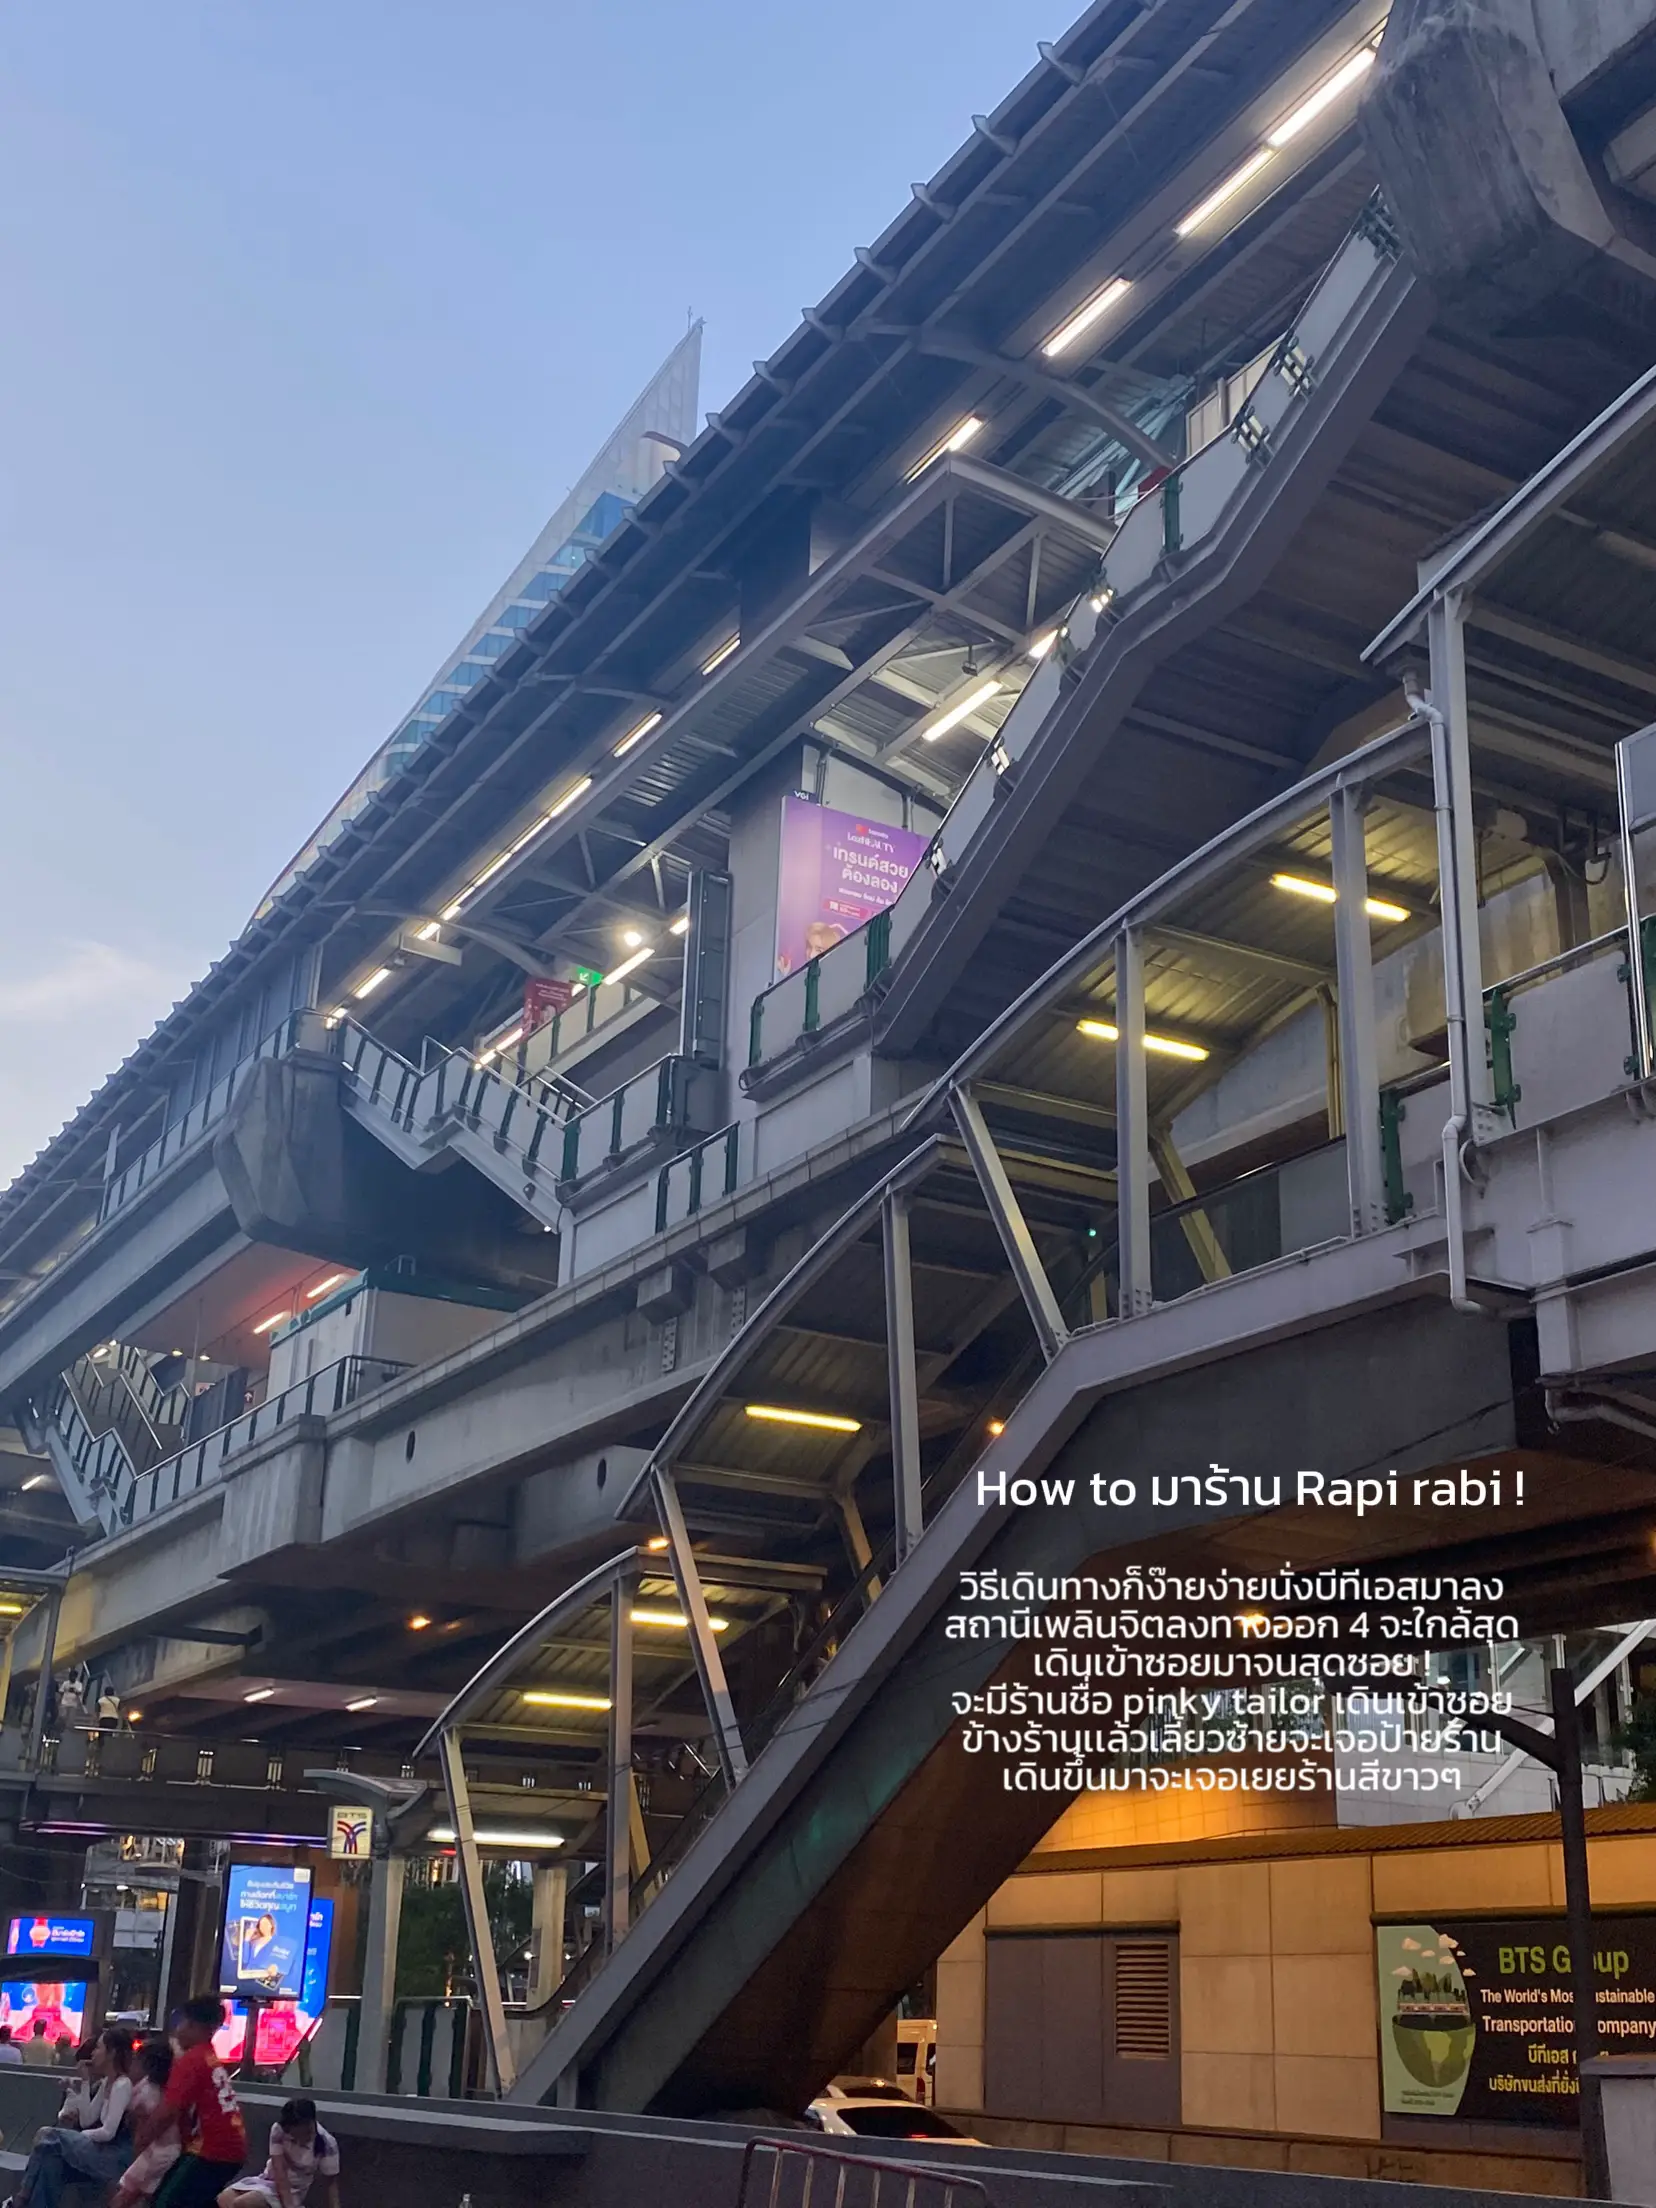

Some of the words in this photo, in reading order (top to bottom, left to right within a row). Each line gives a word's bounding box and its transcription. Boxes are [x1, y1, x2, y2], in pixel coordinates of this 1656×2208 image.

[833, 846, 909, 879] เทรนด์สวย
[842, 863, 899, 894] ต้องลอง
[1499, 1946, 1546, 1974] BTS
[1552, 1945, 1629, 1980] Gup
[1480, 1988, 1502, 2004] The
[1503, 1988, 1548, 2004] World's
[1550, 1988, 1574, 2004] Mos
[1596, 1987, 1656, 2004] stainable
[1482, 2015, 1576, 2036] Transportatio
[1597, 2019, 1656, 2039] ompany
[1528, 2043, 1569, 2064] บีทีเอส
